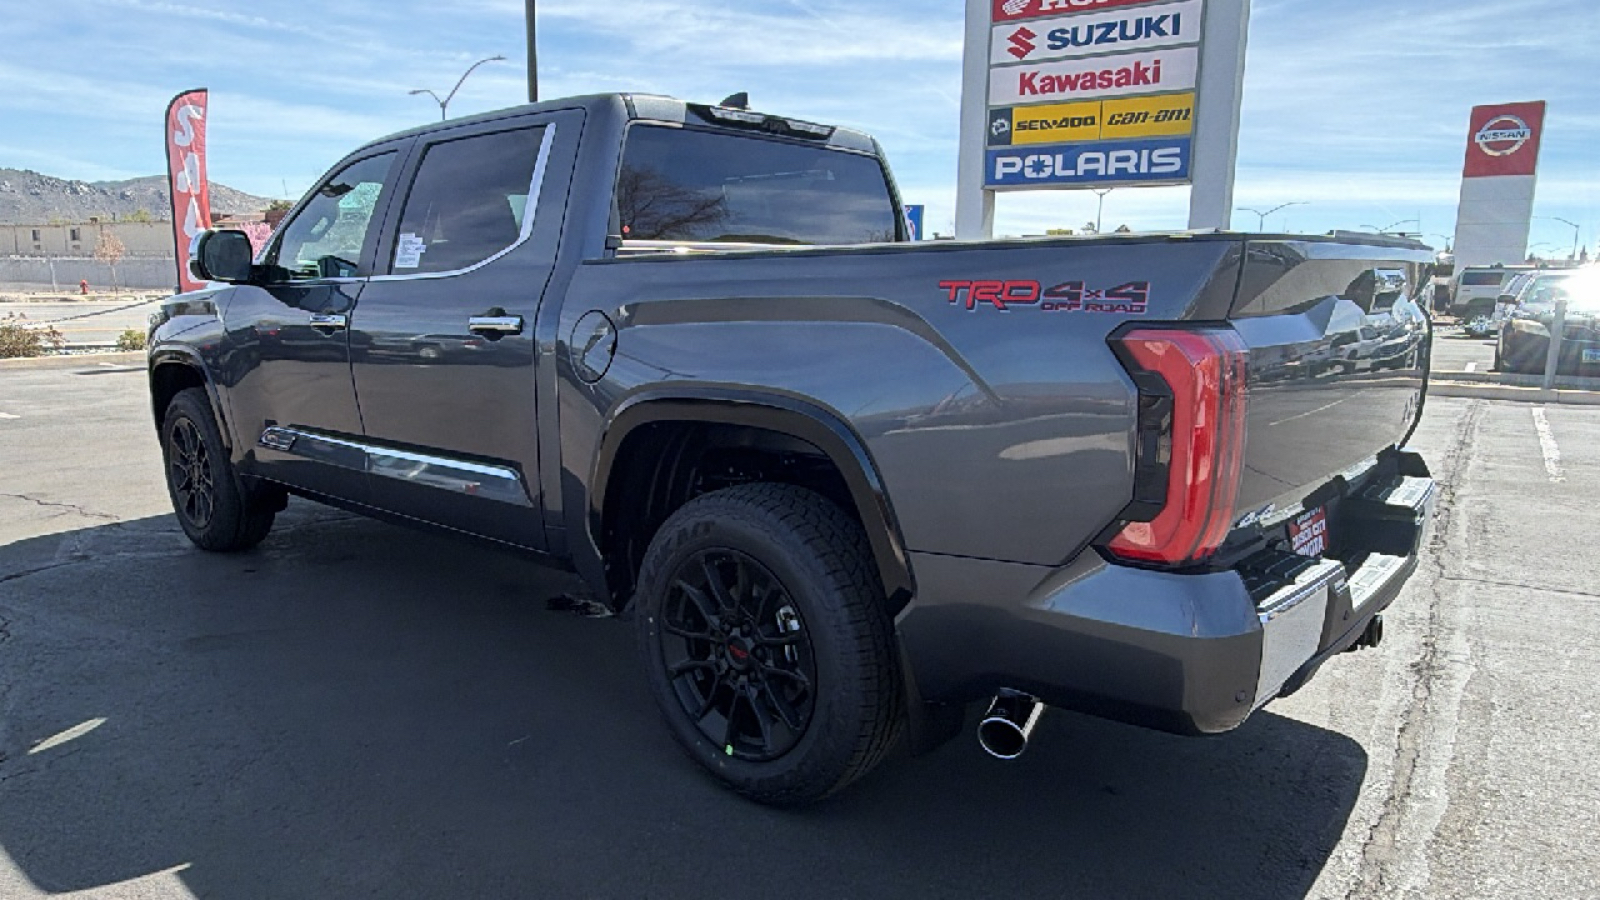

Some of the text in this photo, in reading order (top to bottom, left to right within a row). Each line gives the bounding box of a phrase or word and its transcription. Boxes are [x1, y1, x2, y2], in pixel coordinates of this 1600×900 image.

[1047, 13, 1180, 50] SUZUKI
[1019, 59, 1161, 96] Kawasaki
[1479, 131, 1525, 141] NISSAN
[995, 147, 1181, 180] POLARIS
[939, 280, 1041, 310] TRD
[1040, 303, 1146, 313] OFF ROAD
